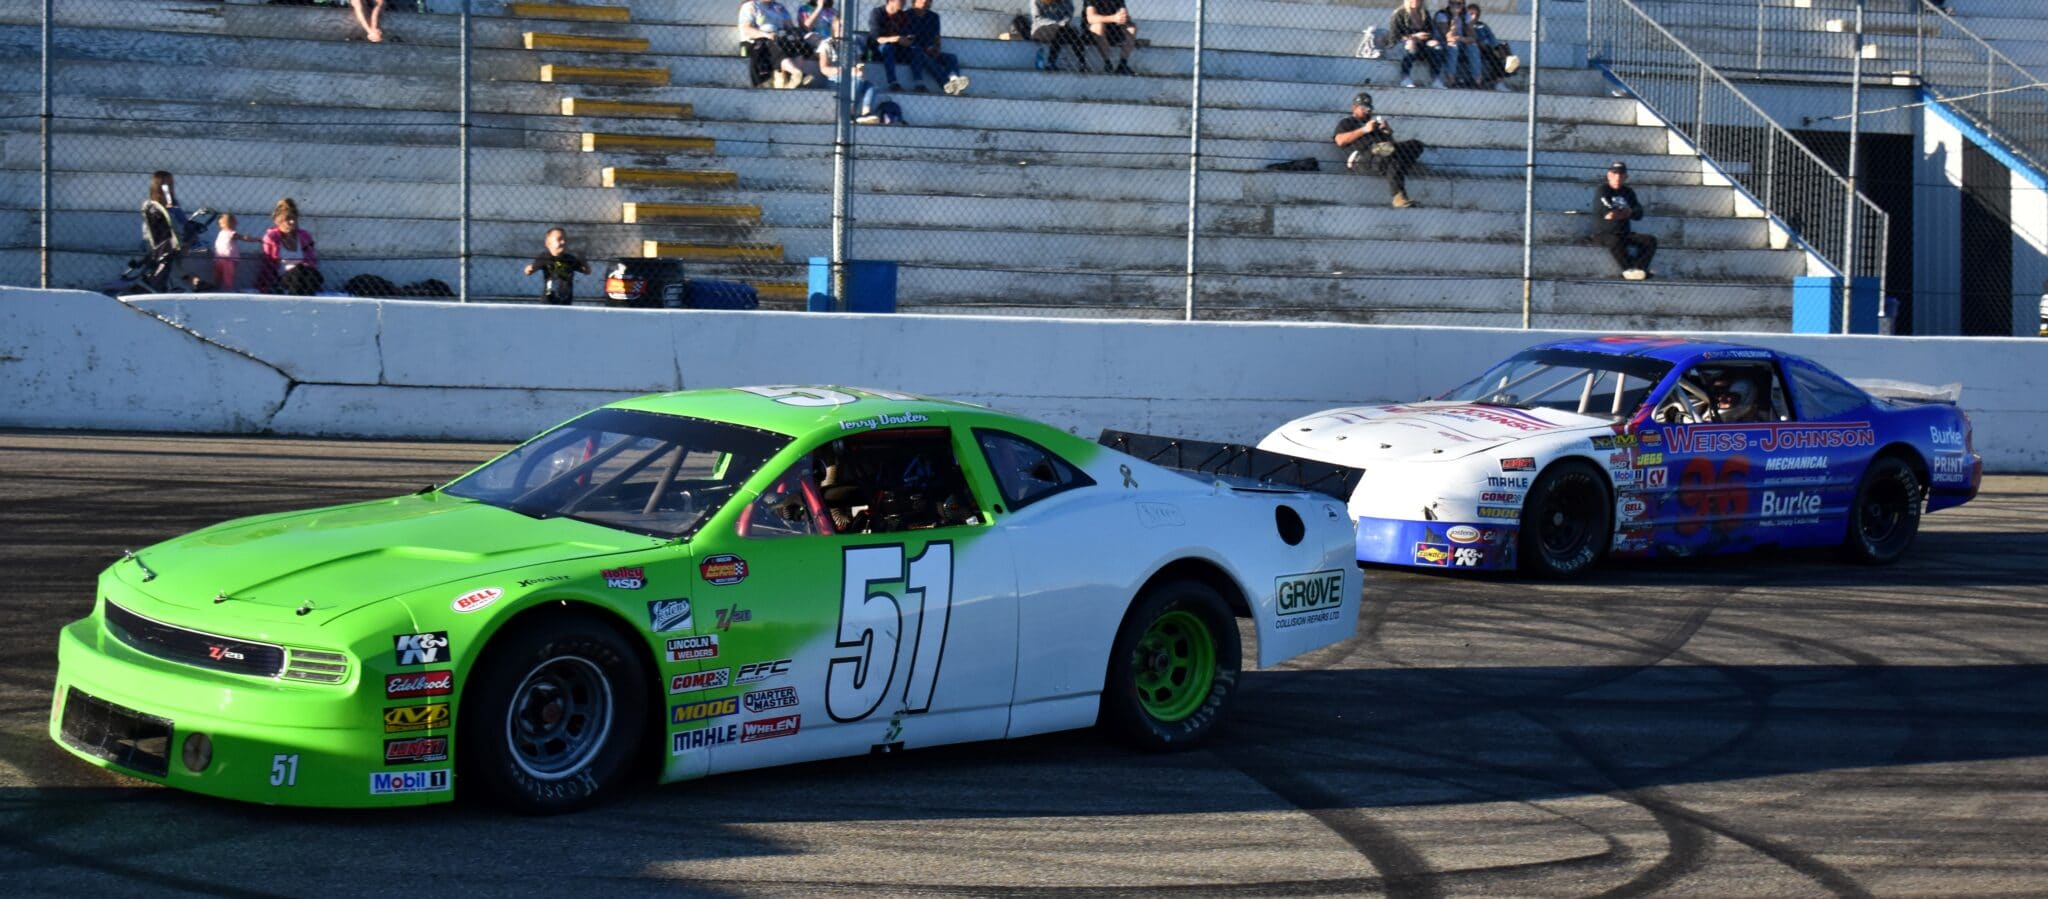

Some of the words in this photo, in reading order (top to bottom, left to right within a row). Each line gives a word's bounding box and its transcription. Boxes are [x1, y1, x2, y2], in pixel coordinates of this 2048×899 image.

[1930, 425, 1963, 445] Burke
[1637, 453, 1662, 465] JEGS
[1765, 456, 1828, 471] MECHANICAL
[1934, 456, 1964, 473] PRINT
[1488, 477, 1528, 488] MAHLE
[1649, 469, 1665, 484] CV
[1481, 493, 1514, 502] COMP
[1760, 491, 1822, 516] Burke
[1480, 508, 1519, 518] MOOG
[1625, 503, 1642, 512] BELL
[608, 578, 642, 588] MSD
[458, 588, 496, 608] BELL
[1279, 576, 1341, 609] GROVE
[1276, 615, 1306, 629] COLLISION
[825, 540, 953, 723] 51
[669, 637, 709, 650] LINCOLN
[209, 646, 244, 660] Z/28
[678, 647, 714, 659] WELDERS
[738, 660, 792, 678] PFC
[388, 676, 451, 693] Edelbrock
[672, 672, 715, 690] COMP
[744, 688, 793, 706] QUARTER
[754, 696, 796, 711] MASTER
[675, 699, 737, 720] MOOG
[744, 719, 798, 735] WHELEN
[674, 725, 737, 752] MAHLE
[270, 754, 298, 785] 51
[374, 772, 426, 789] Mobil
